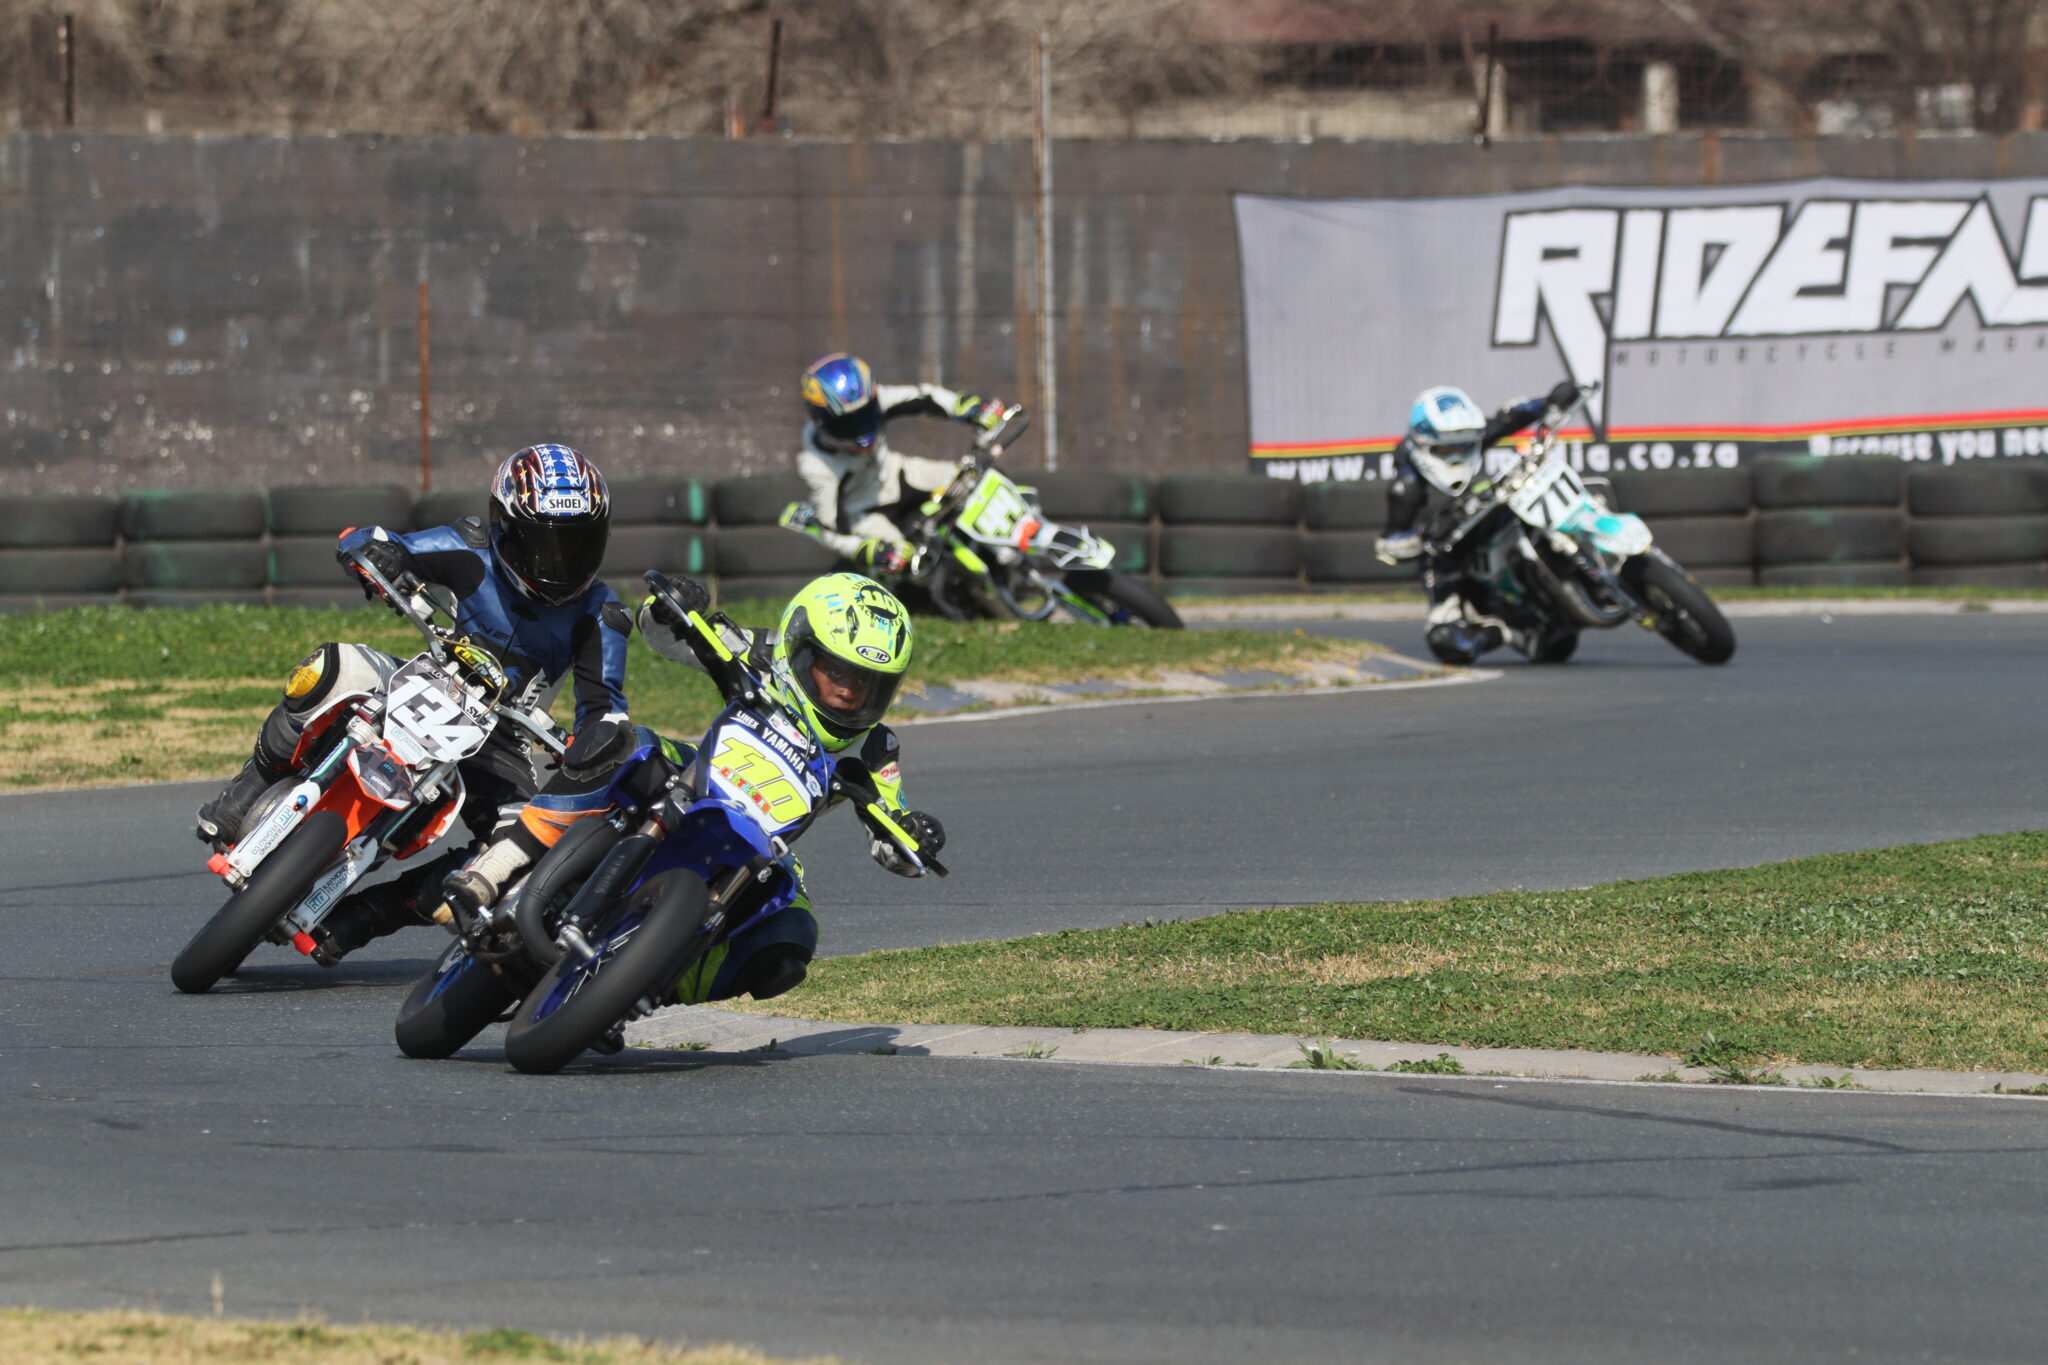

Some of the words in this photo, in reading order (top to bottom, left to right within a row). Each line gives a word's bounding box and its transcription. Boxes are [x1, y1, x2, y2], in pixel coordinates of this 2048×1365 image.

[1614, 340, 1896, 367] MOTORCYCLE
[1937, 430, 1997, 466] you
[2003, 427, 2048, 457] ne
[549, 498, 582, 510] SHOEI
[1527, 471, 1580, 528] 711
[388, 675, 486, 763] 134
[735, 710, 760, 731] LINEX
[761, 727, 806, 775] YAMAHA
[710, 737, 810, 824] 110
[258, 828, 283, 856] RAYMOND
[321, 863, 349, 890] RAYMOND
[308, 890, 326, 910] RTF
